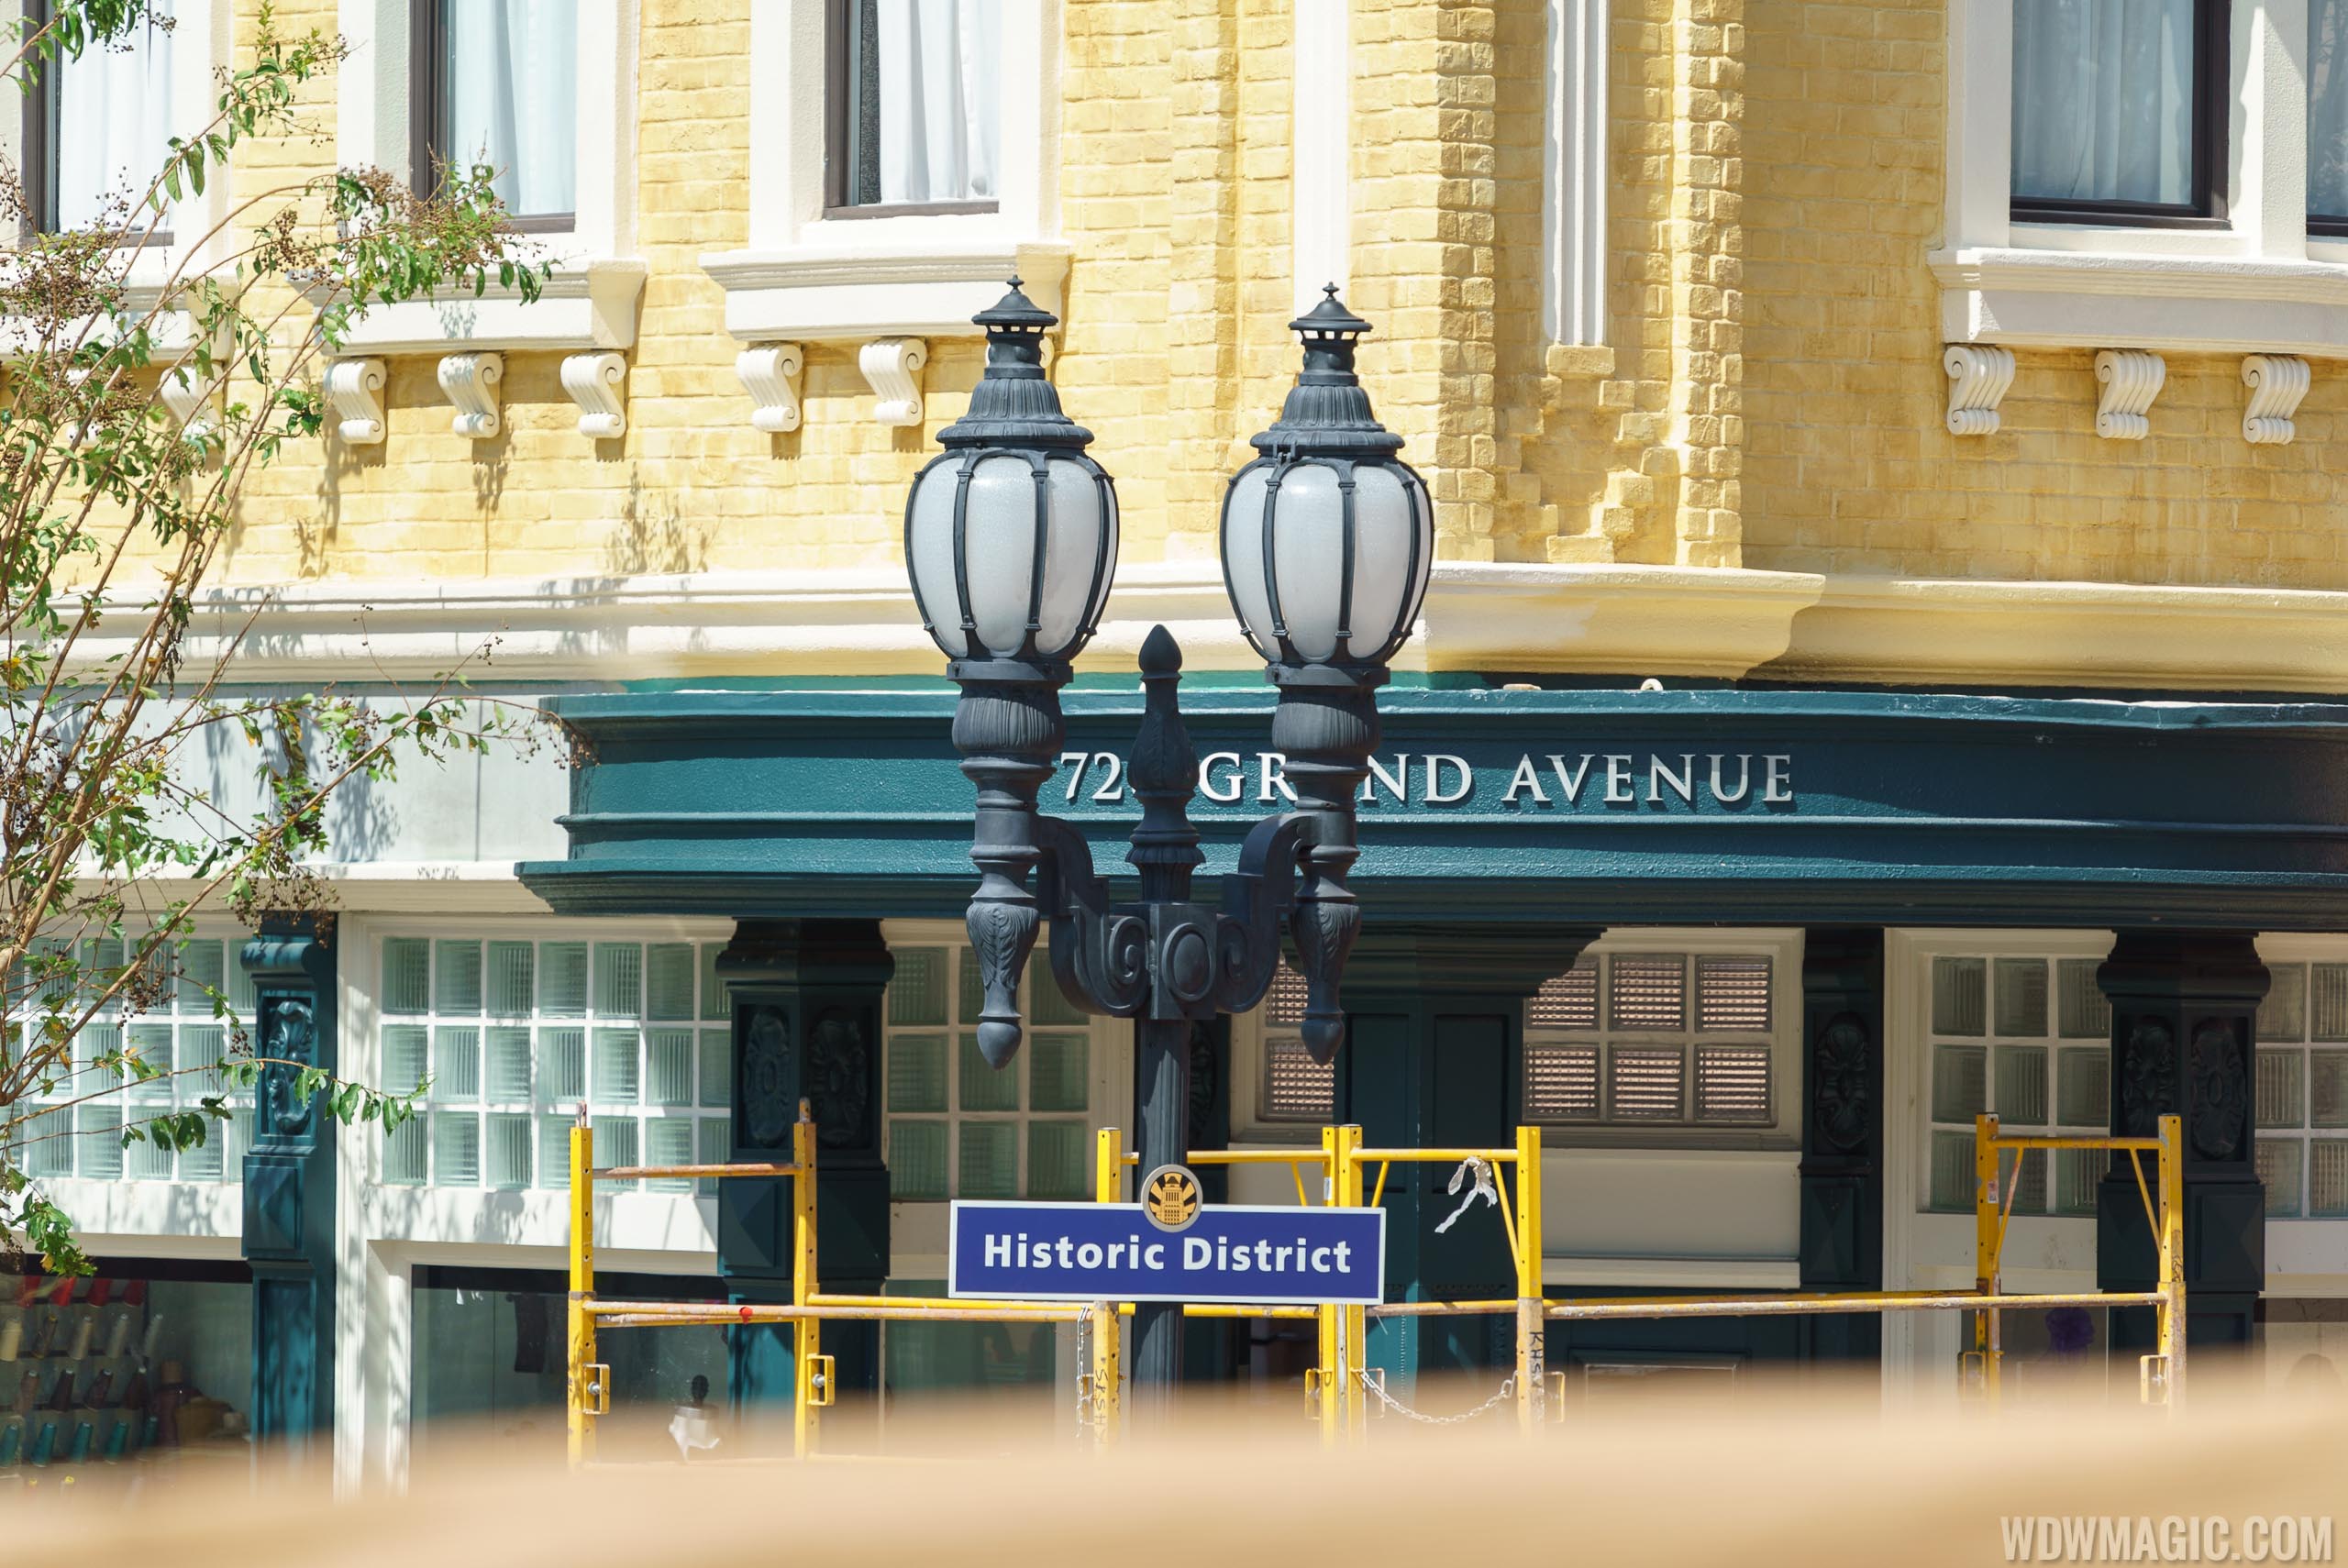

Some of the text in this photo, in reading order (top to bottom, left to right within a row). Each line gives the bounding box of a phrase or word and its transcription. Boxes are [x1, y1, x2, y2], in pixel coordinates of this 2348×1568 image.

[1060, 751, 1793, 802] 72 GRND AVENUE
[983, 1233, 1351, 1274] Historic District
